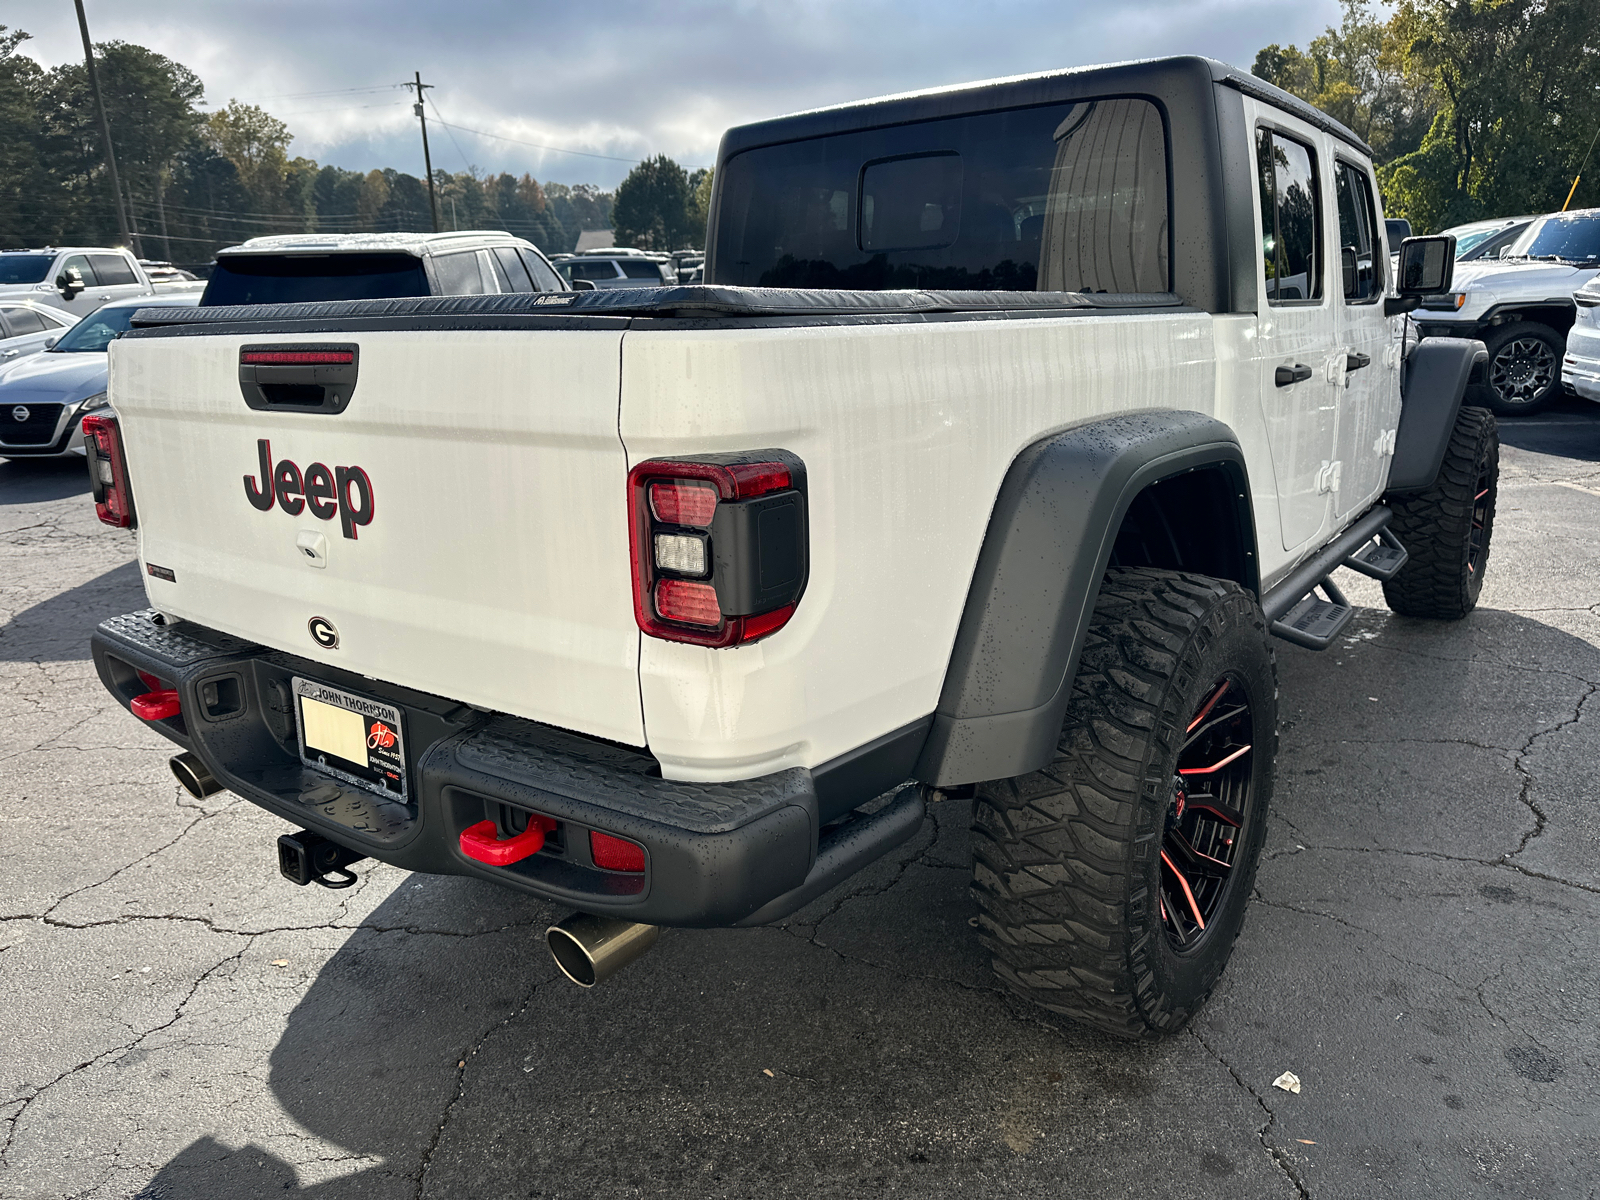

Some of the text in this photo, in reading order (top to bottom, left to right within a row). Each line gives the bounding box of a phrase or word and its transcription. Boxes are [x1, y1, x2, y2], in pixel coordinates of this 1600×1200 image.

[243, 438, 374, 540] Jeep
[309, 618, 336, 647] G
[318, 688, 343, 706] JOHN
[343, 695, 395, 722] THORNTON
